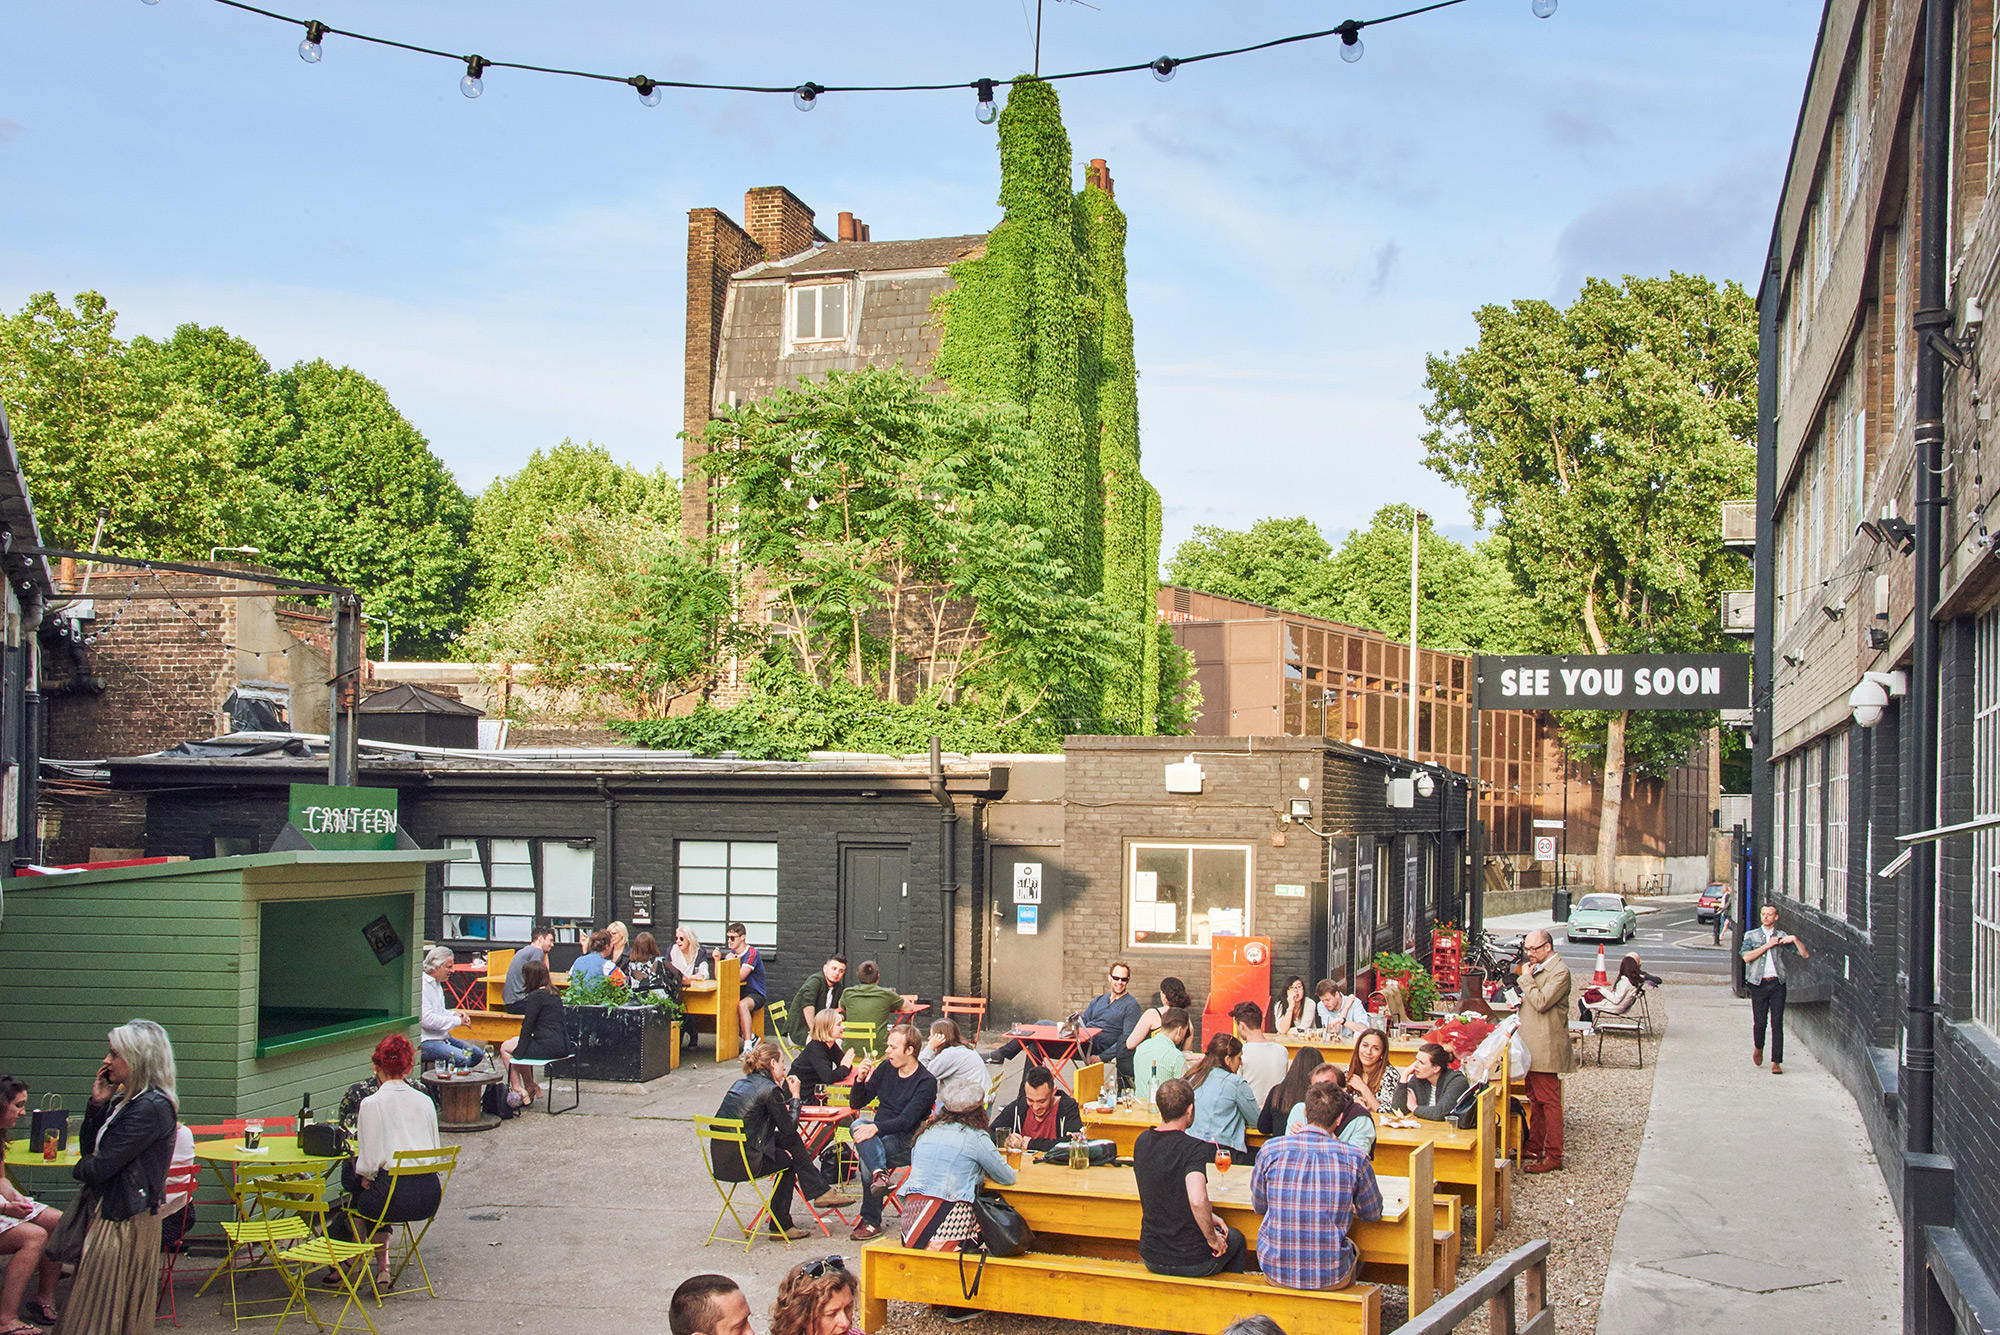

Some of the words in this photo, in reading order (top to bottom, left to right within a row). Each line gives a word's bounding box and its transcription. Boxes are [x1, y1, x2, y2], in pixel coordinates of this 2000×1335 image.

[1500, 668, 1550, 696] SEE
[1560, 668, 1623, 696] YOU
[1634, 667, 1720, 696] SOON
[308, 806, 398, 833] CANTEEN
[1017, 877, 1038, 887] STAFF
[1017, 887, 1038, 899] ONLY
[375, 932, 393, 949] 66
